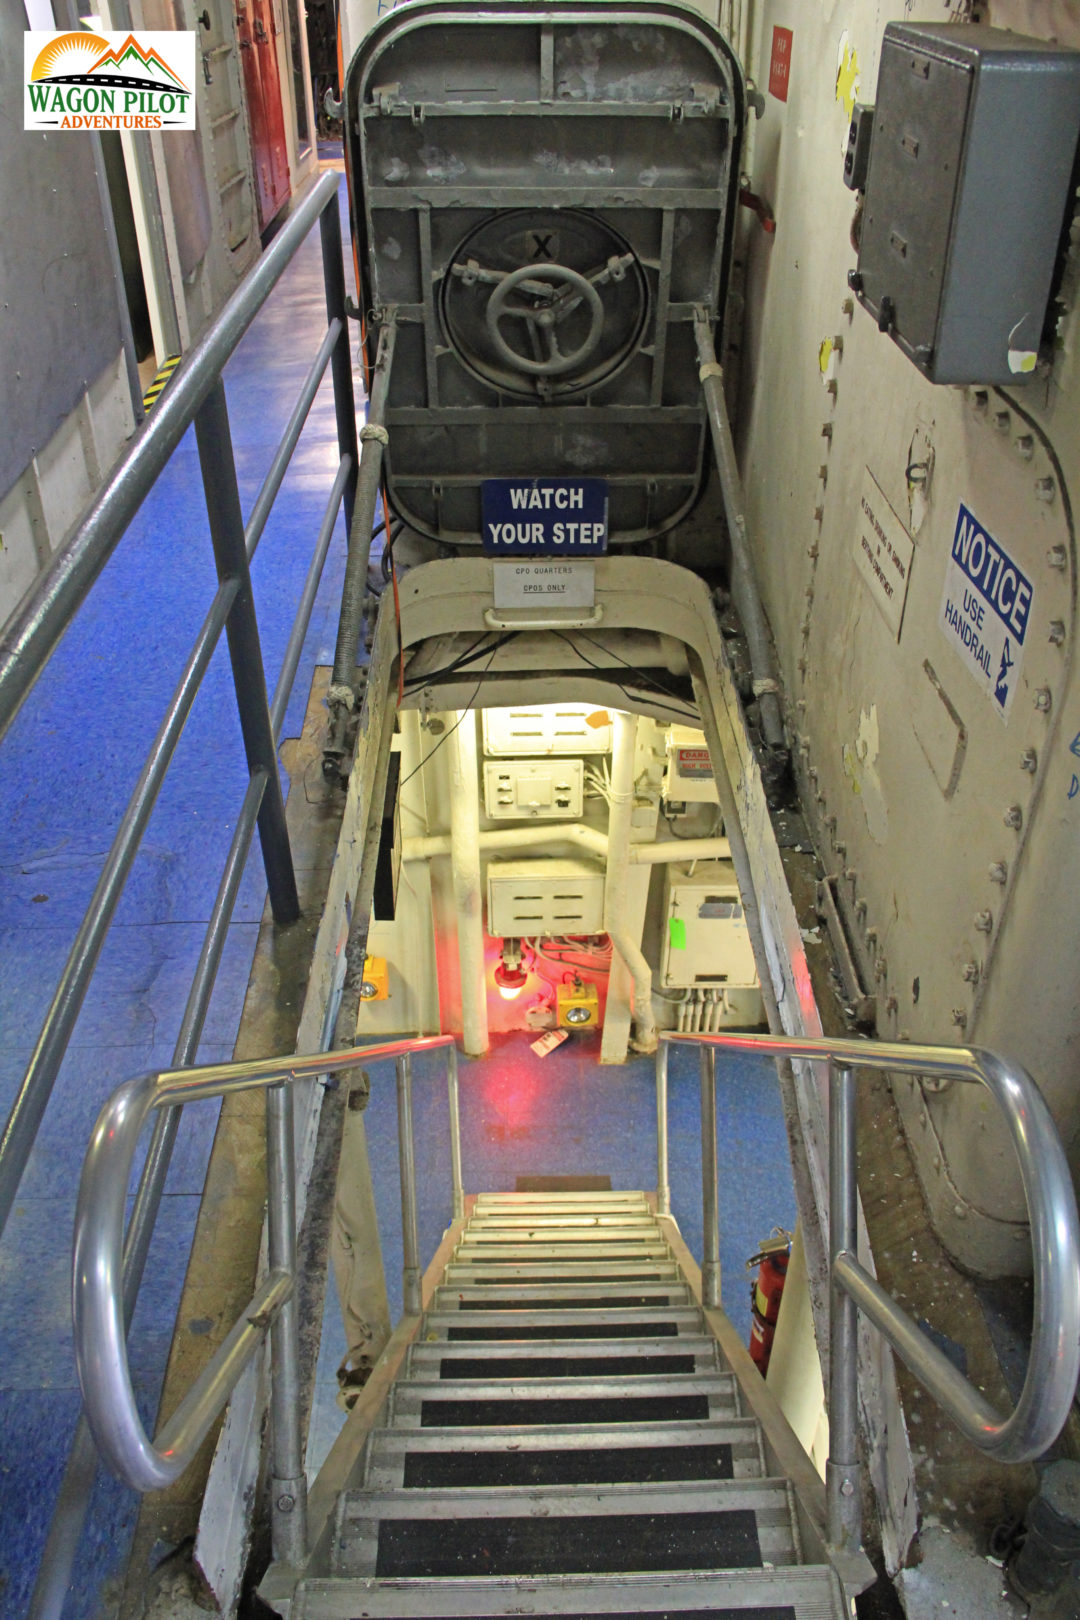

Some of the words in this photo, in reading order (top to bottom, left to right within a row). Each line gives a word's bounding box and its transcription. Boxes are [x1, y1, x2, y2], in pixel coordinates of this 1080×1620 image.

[510, 488, 584, 509] WATCH
[488, 523, 545, 544] YOUR
[552, 523, 605, 544] STEP
[955, 515, 1031, 633] NOTICE
[963, 589, 985, 631] USE
[945, 599, 992, 678] HANDRAIL
